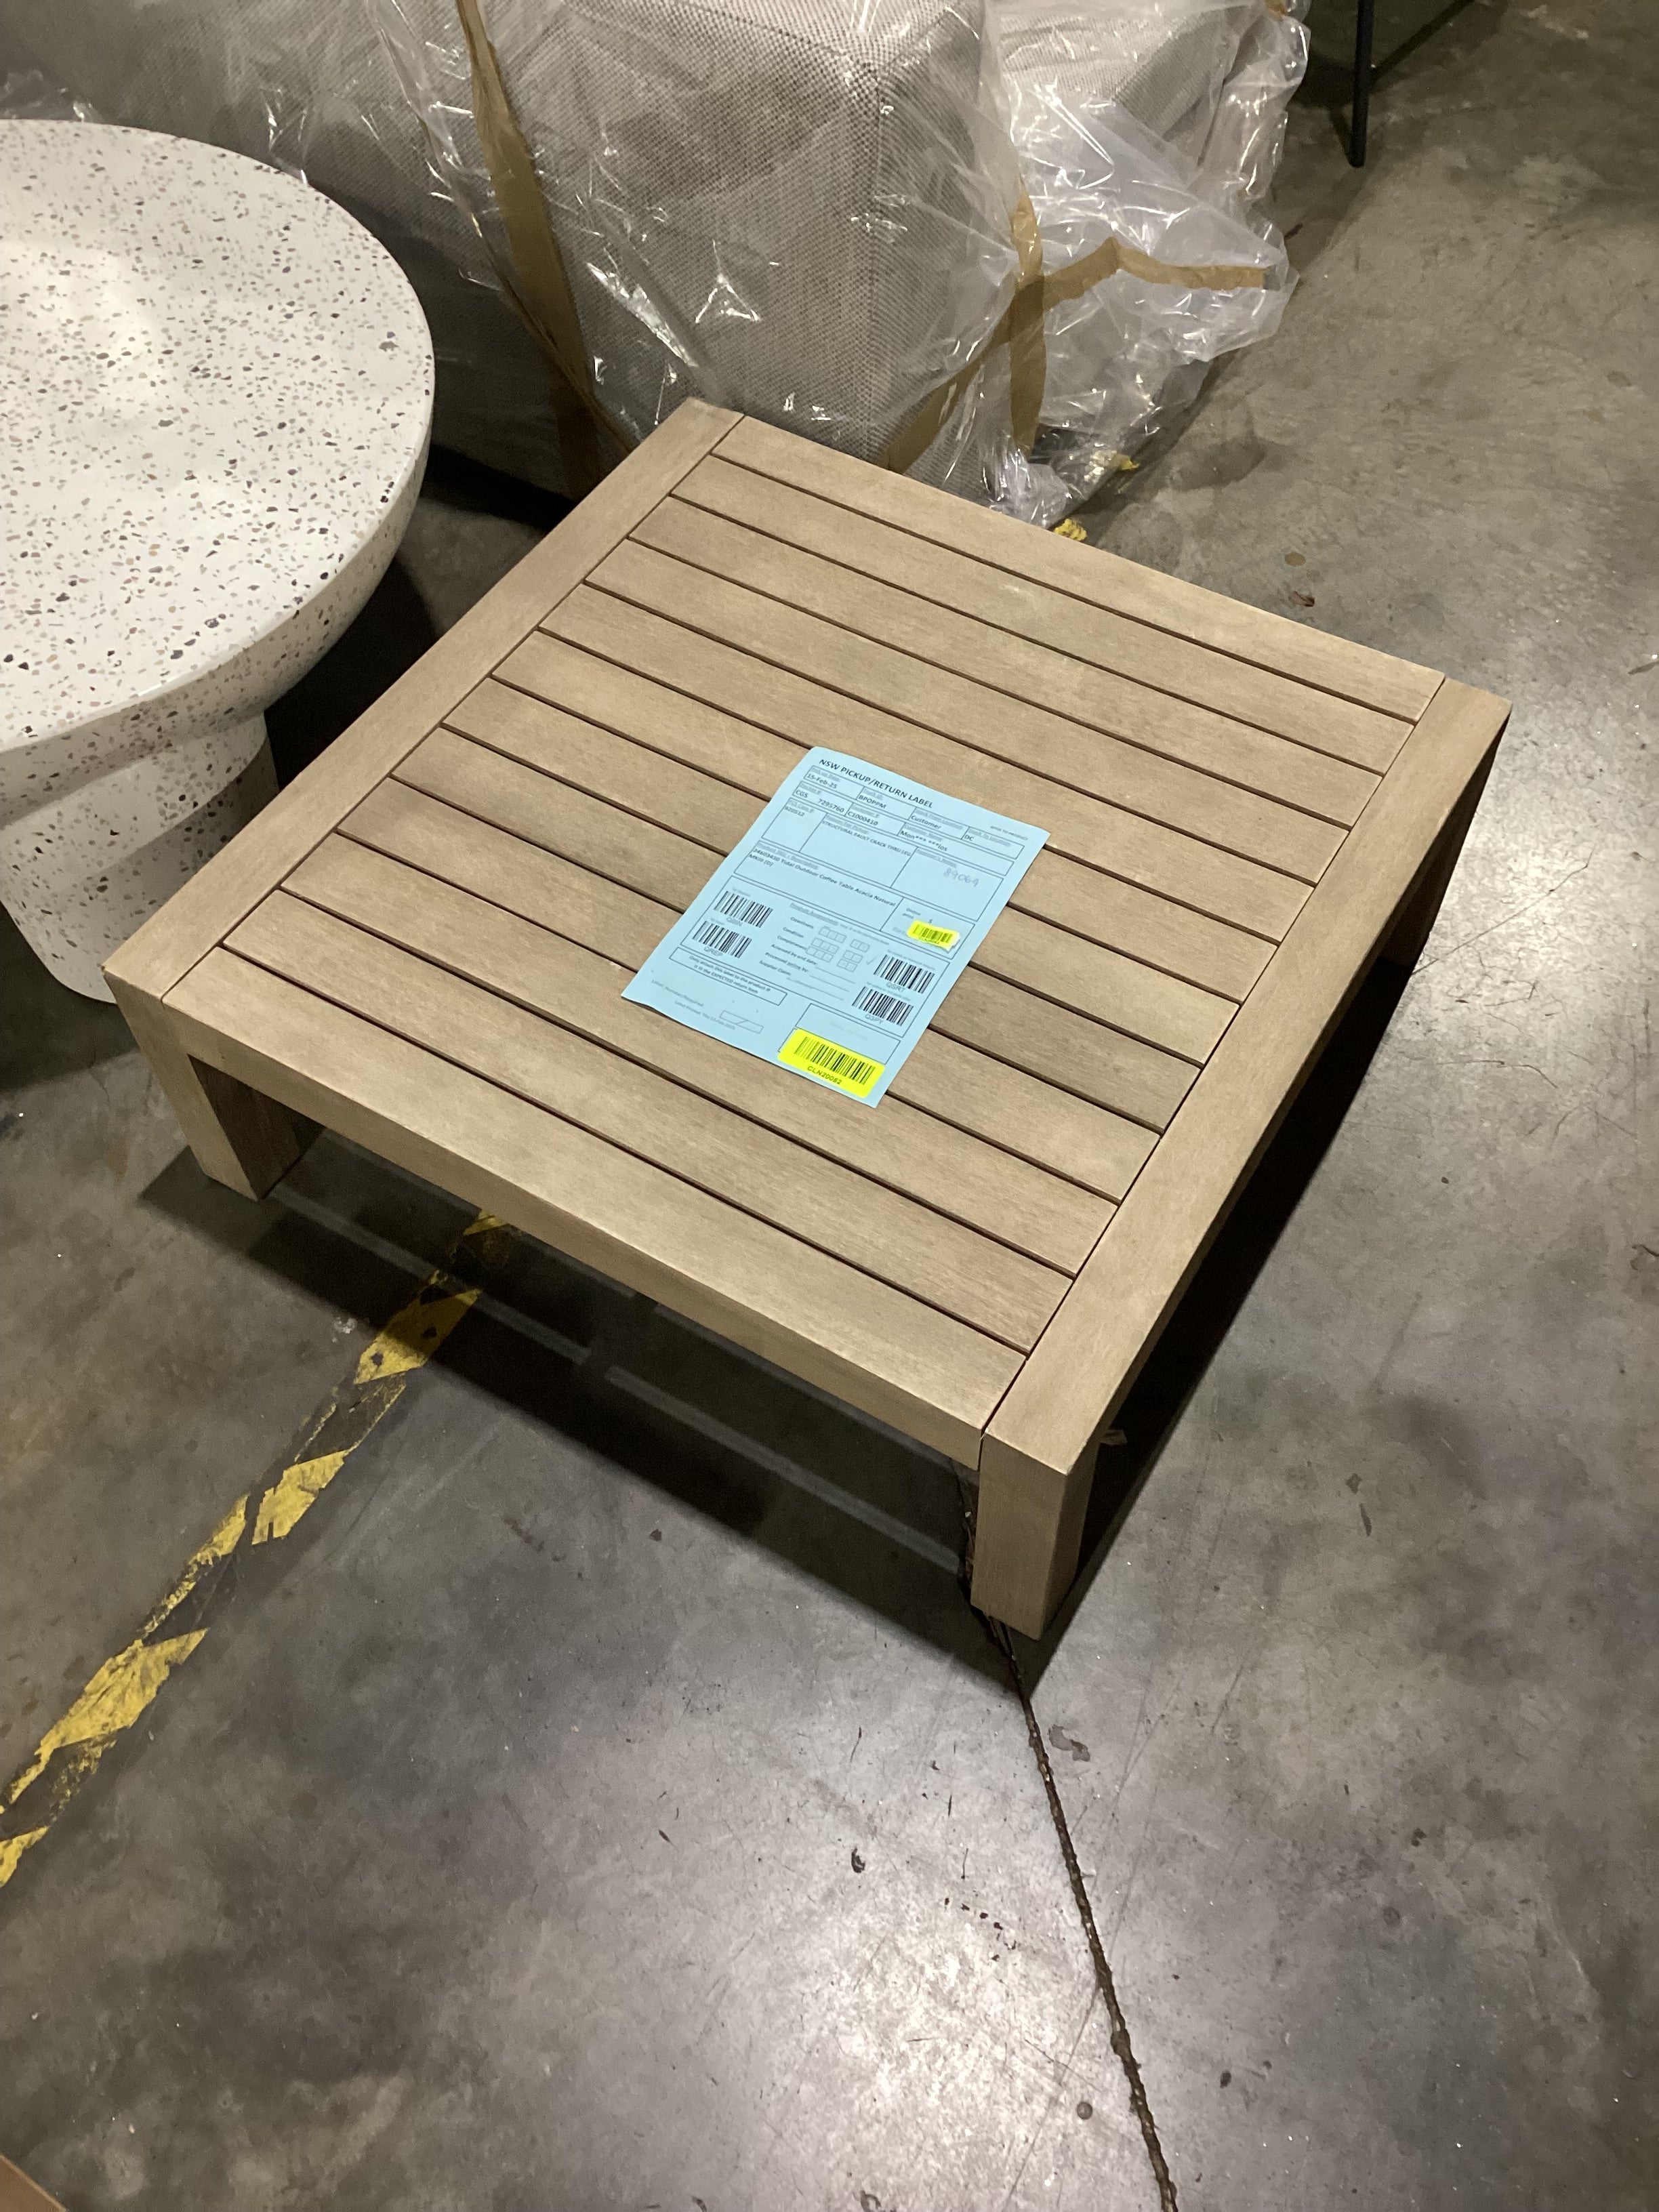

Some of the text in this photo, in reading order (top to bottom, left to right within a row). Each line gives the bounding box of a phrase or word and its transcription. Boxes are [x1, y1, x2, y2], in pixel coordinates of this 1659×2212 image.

[819, 758, 934, 808] NSW PICKUP/RETURN LABEL
[794, 790, 809, 798] CGS
[910, 815, 942, 830] Customer
[780, 859, 795, 867] Tidal
[794, 864, 819, 877] Outdoor
[818, 874, 839, 884] Coffee
[838, 881, 855, 890] Table
[855, 888, 874, 898] Acacia
[873, 895, 896, 906] Natural
[884, 981, 905, 993] QSRT
